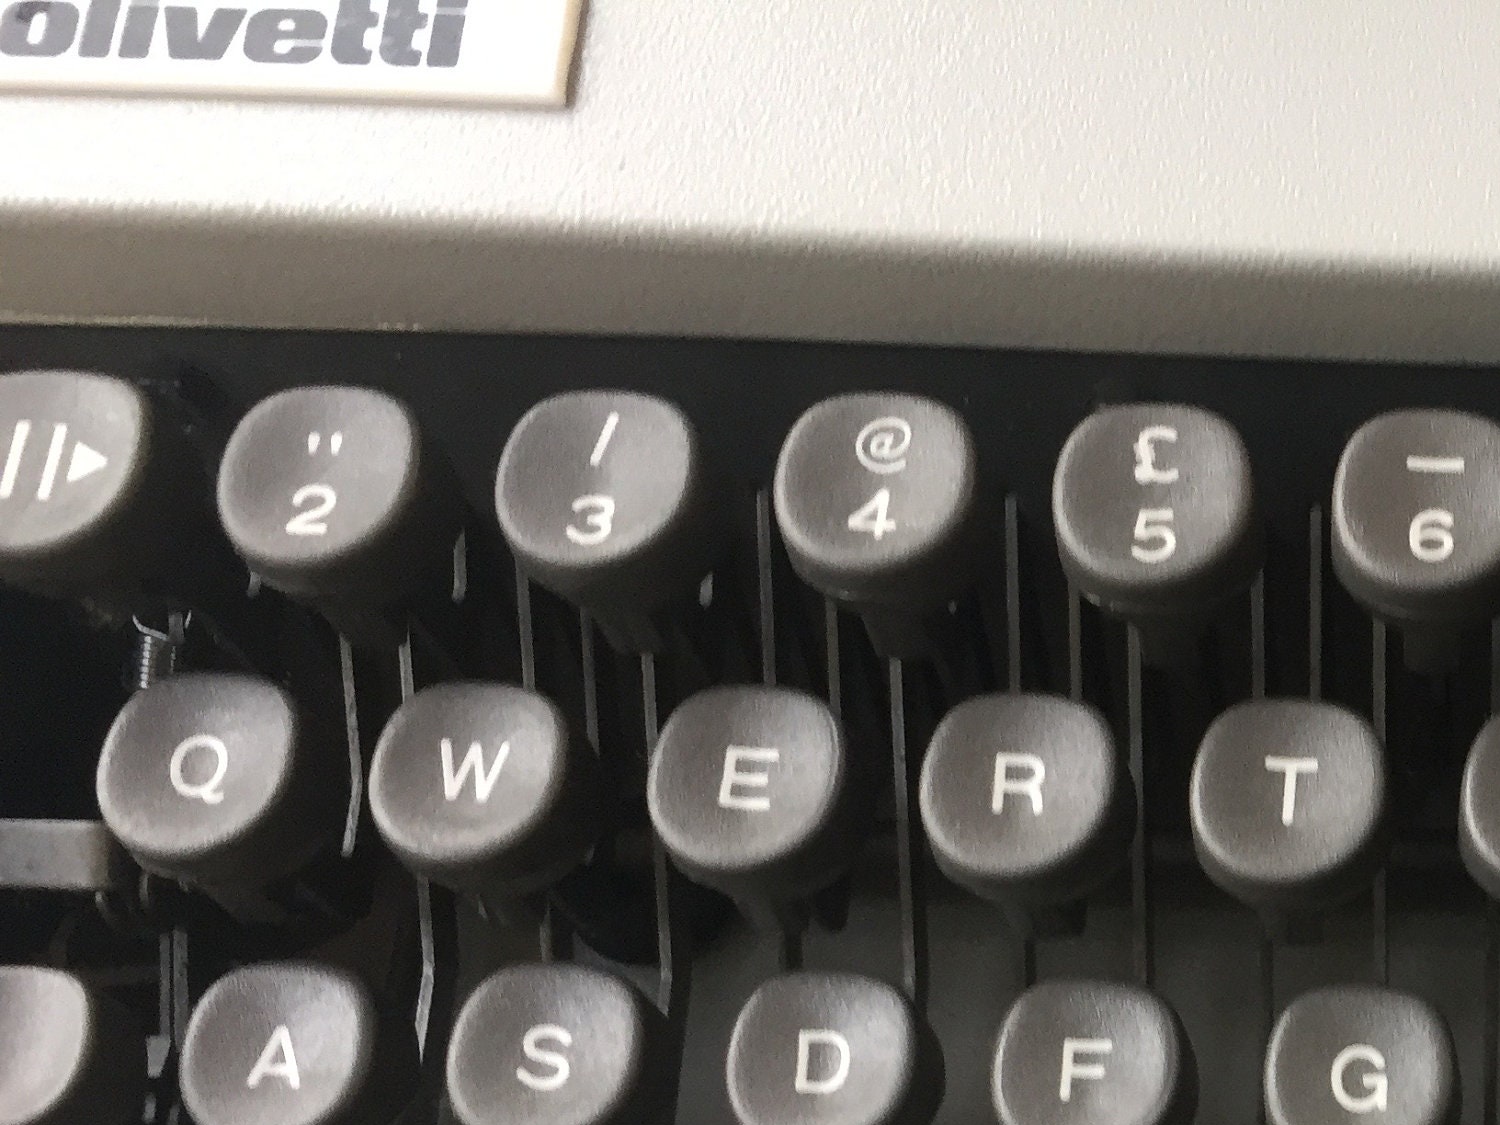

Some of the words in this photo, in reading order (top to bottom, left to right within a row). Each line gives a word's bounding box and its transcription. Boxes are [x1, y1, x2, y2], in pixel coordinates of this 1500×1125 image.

[0, 0, 468, 68] olivetti
[855, 416, 912, 474] @
[1133, 425, 1180, 485] £
[286, 485, 337, 536] 2
[566, 495, 615, 546] 3
[847, 488, 897, 541] 4
[1131, 508, 1176, 564] 5
[1408, 508, 1455, 562] 6
[169, 733, 229, 804] Q
[440, 738, 510, 803] W
[717, 745, 780, 811] E
[991, 752, 1046, 816] R
[1264, 755, 1319, 827] T
[247, 1025, 301, 1090] A
[516, 1024, 572, 1090] S
[795, 1029, 851, 1095] D
[1059, 1037, 1113, 1103] F
[1331, 1044, 1388, 1113] G
